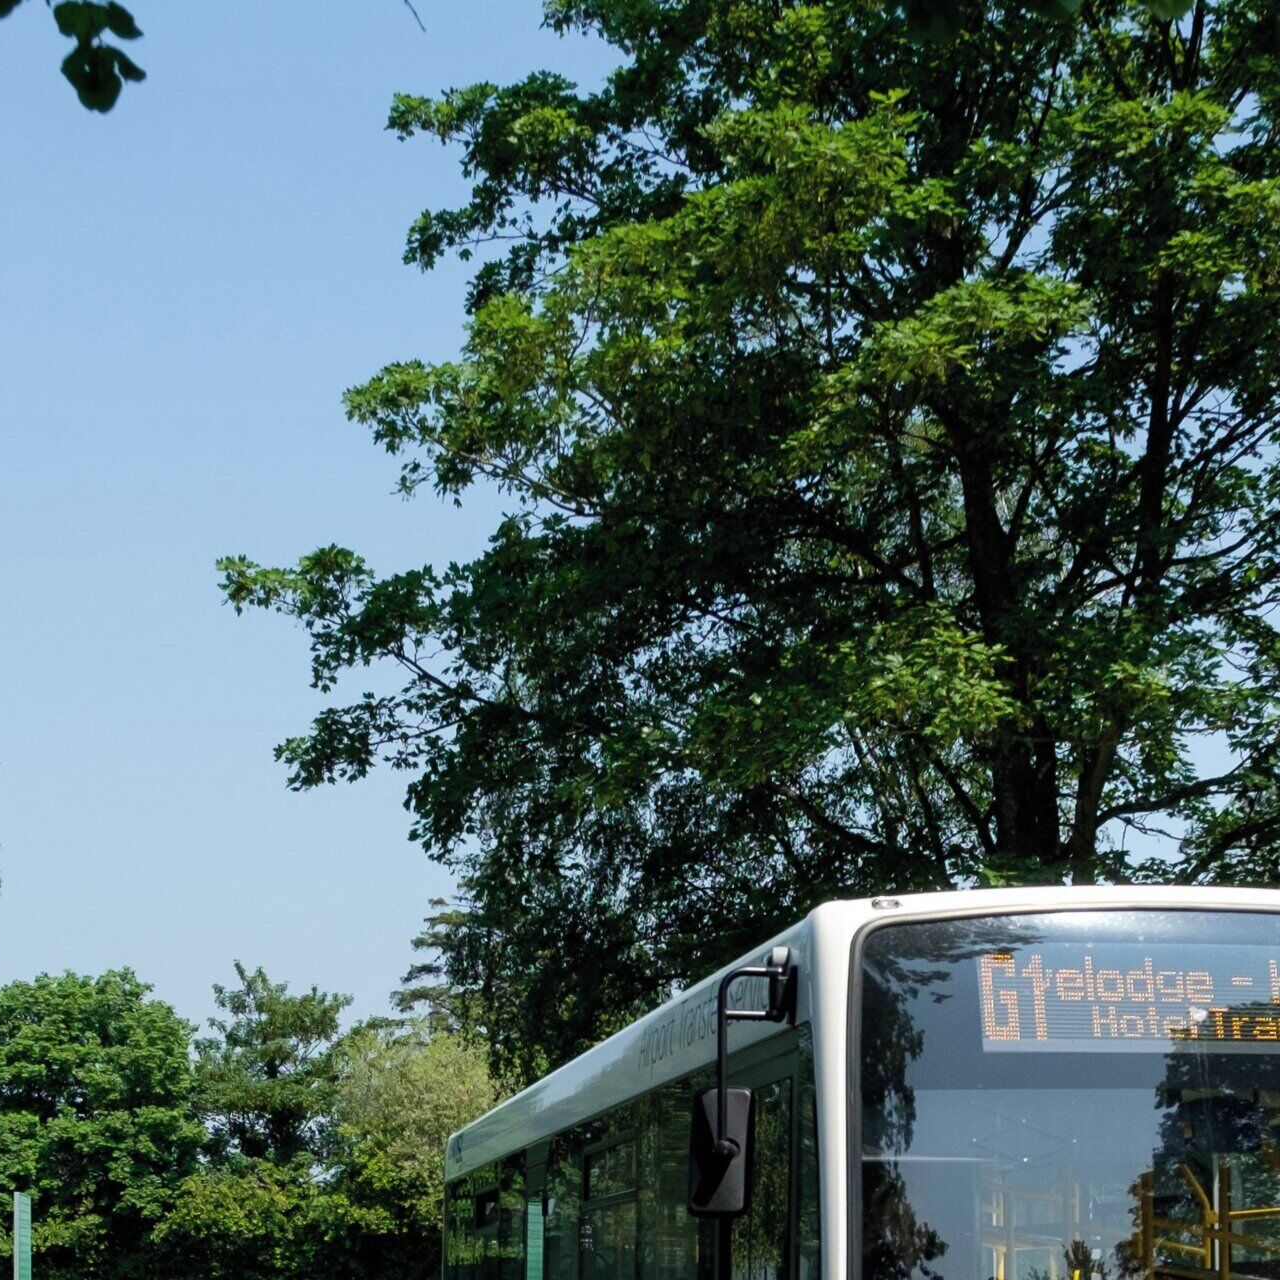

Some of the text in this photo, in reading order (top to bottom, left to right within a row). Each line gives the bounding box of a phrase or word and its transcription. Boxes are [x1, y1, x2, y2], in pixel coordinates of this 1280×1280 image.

[679, 980, 719, 1051] Transfe
[726, 977, 769, 1027] Servic
[1091, 1005, 1199, 1039] Hotel
